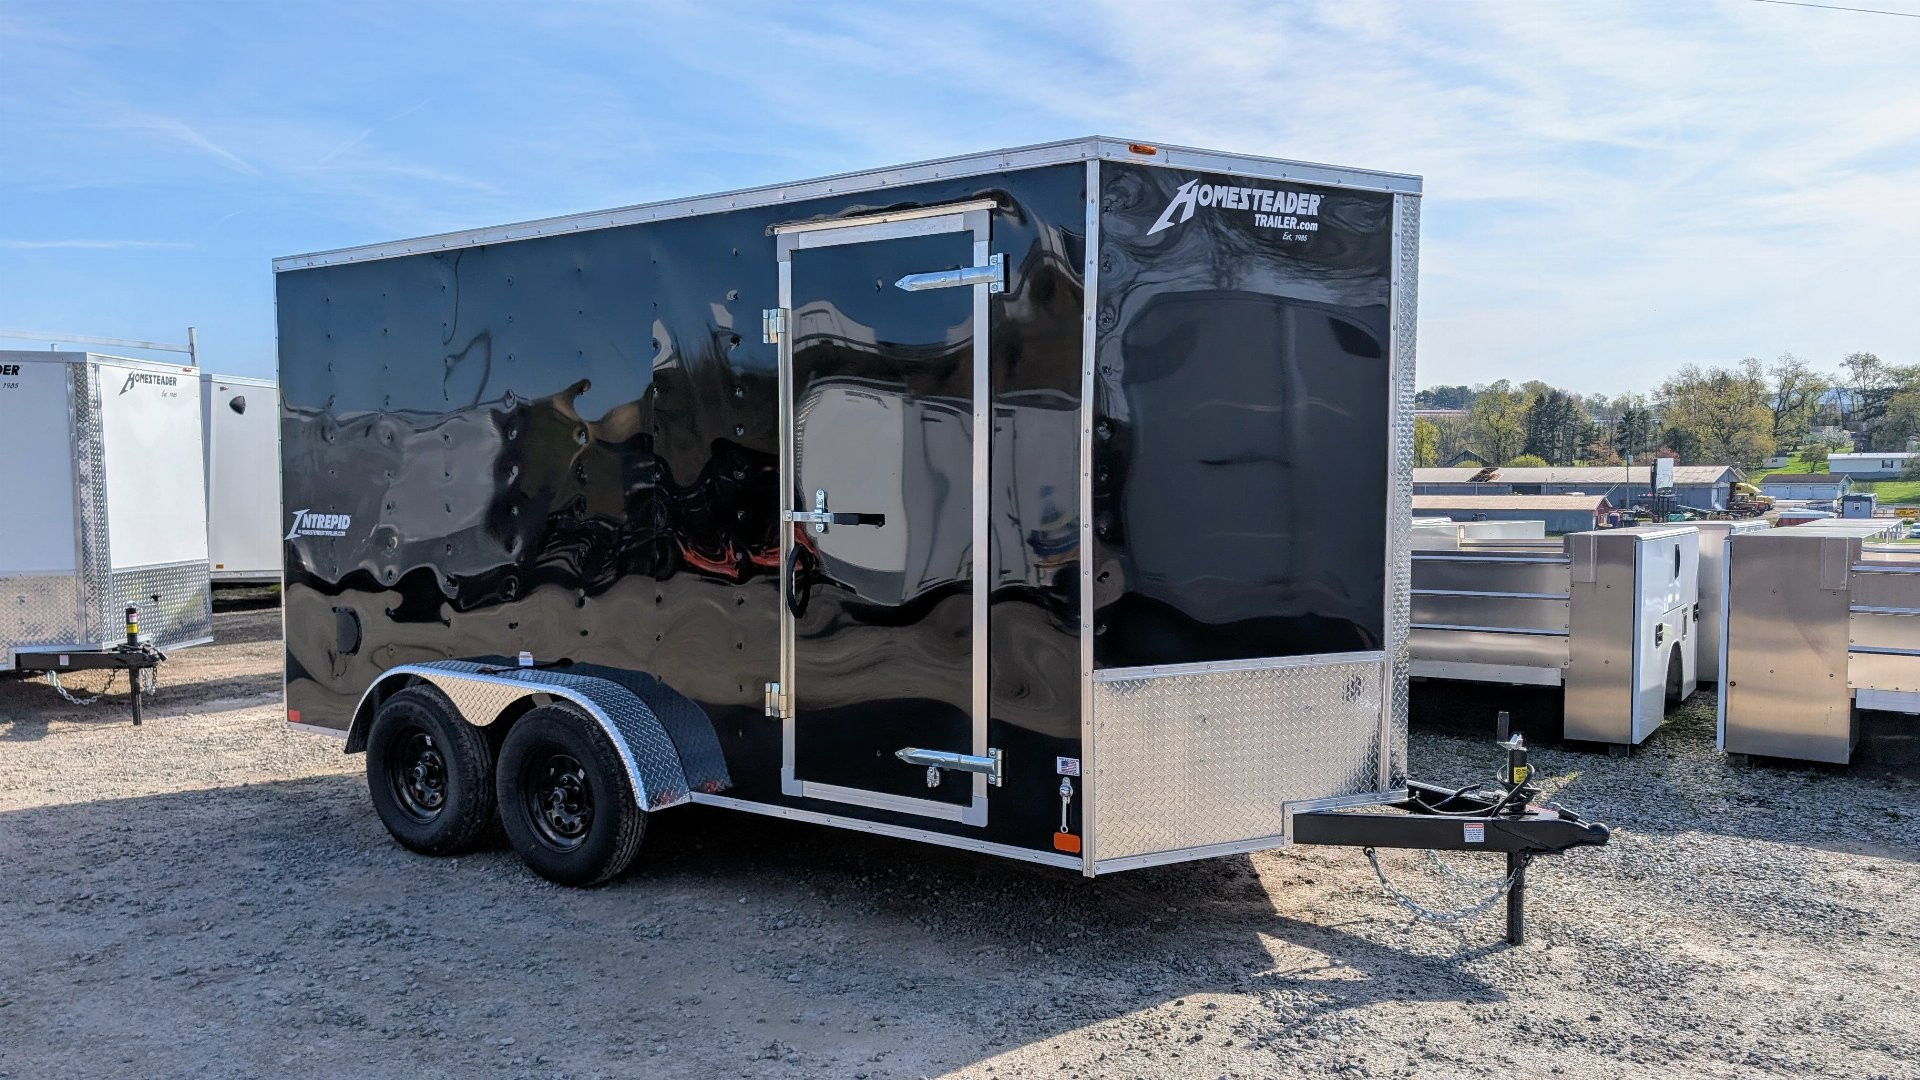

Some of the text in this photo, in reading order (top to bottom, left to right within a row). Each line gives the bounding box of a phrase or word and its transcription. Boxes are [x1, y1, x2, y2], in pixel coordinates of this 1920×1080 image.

[1146, 178, 1321, 236] HOMESTEADER
[1254, 213, 1318, 231] TRAILER.com
[119, 370, 177, 396] HOMESTEADER
[284, 508, 351, 540] INTREPID
